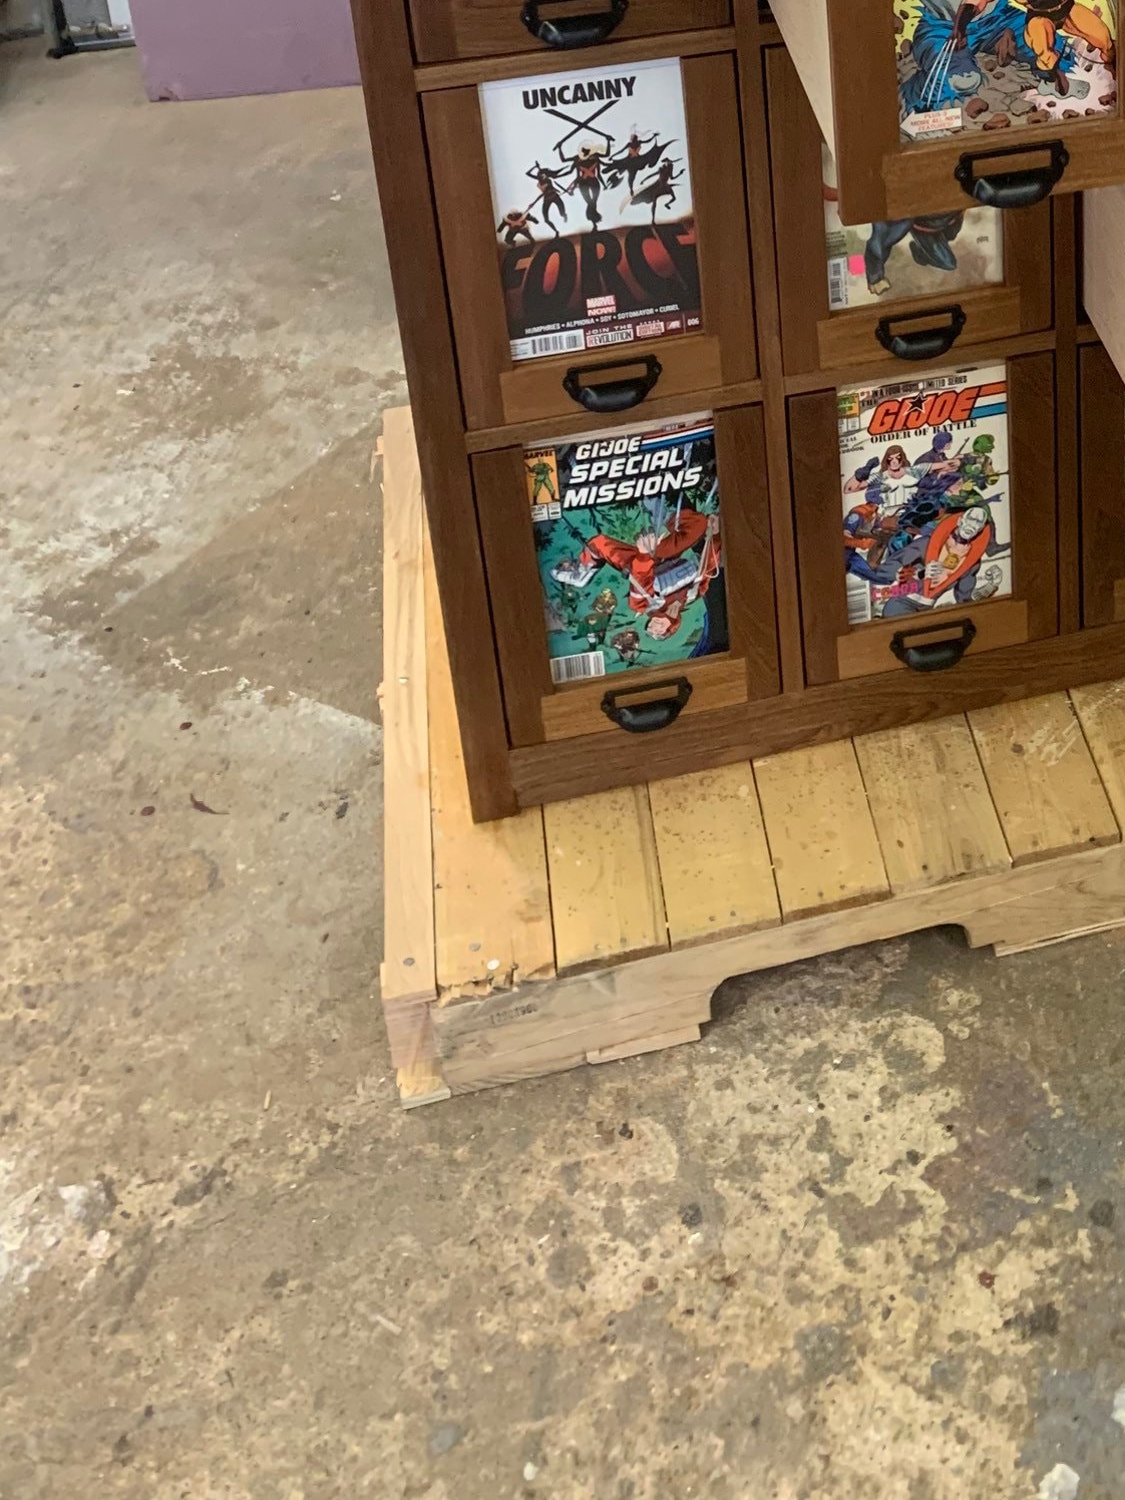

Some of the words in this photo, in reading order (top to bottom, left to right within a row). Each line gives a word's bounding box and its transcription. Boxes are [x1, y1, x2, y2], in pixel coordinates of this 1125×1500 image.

[522, 76, 637, 111] UNCANNY
[586, 327, 609, 336] JOIN
[614, 323, 632, 331] THE
[870, 430, 911, 444] ORDER
[914, 427, 929, 438] OF
[933, 419, 977, 434] BATTLE
[569, 448, 684, 484] SPECIAL
[563, 466, 703, 508] MISSIONS
